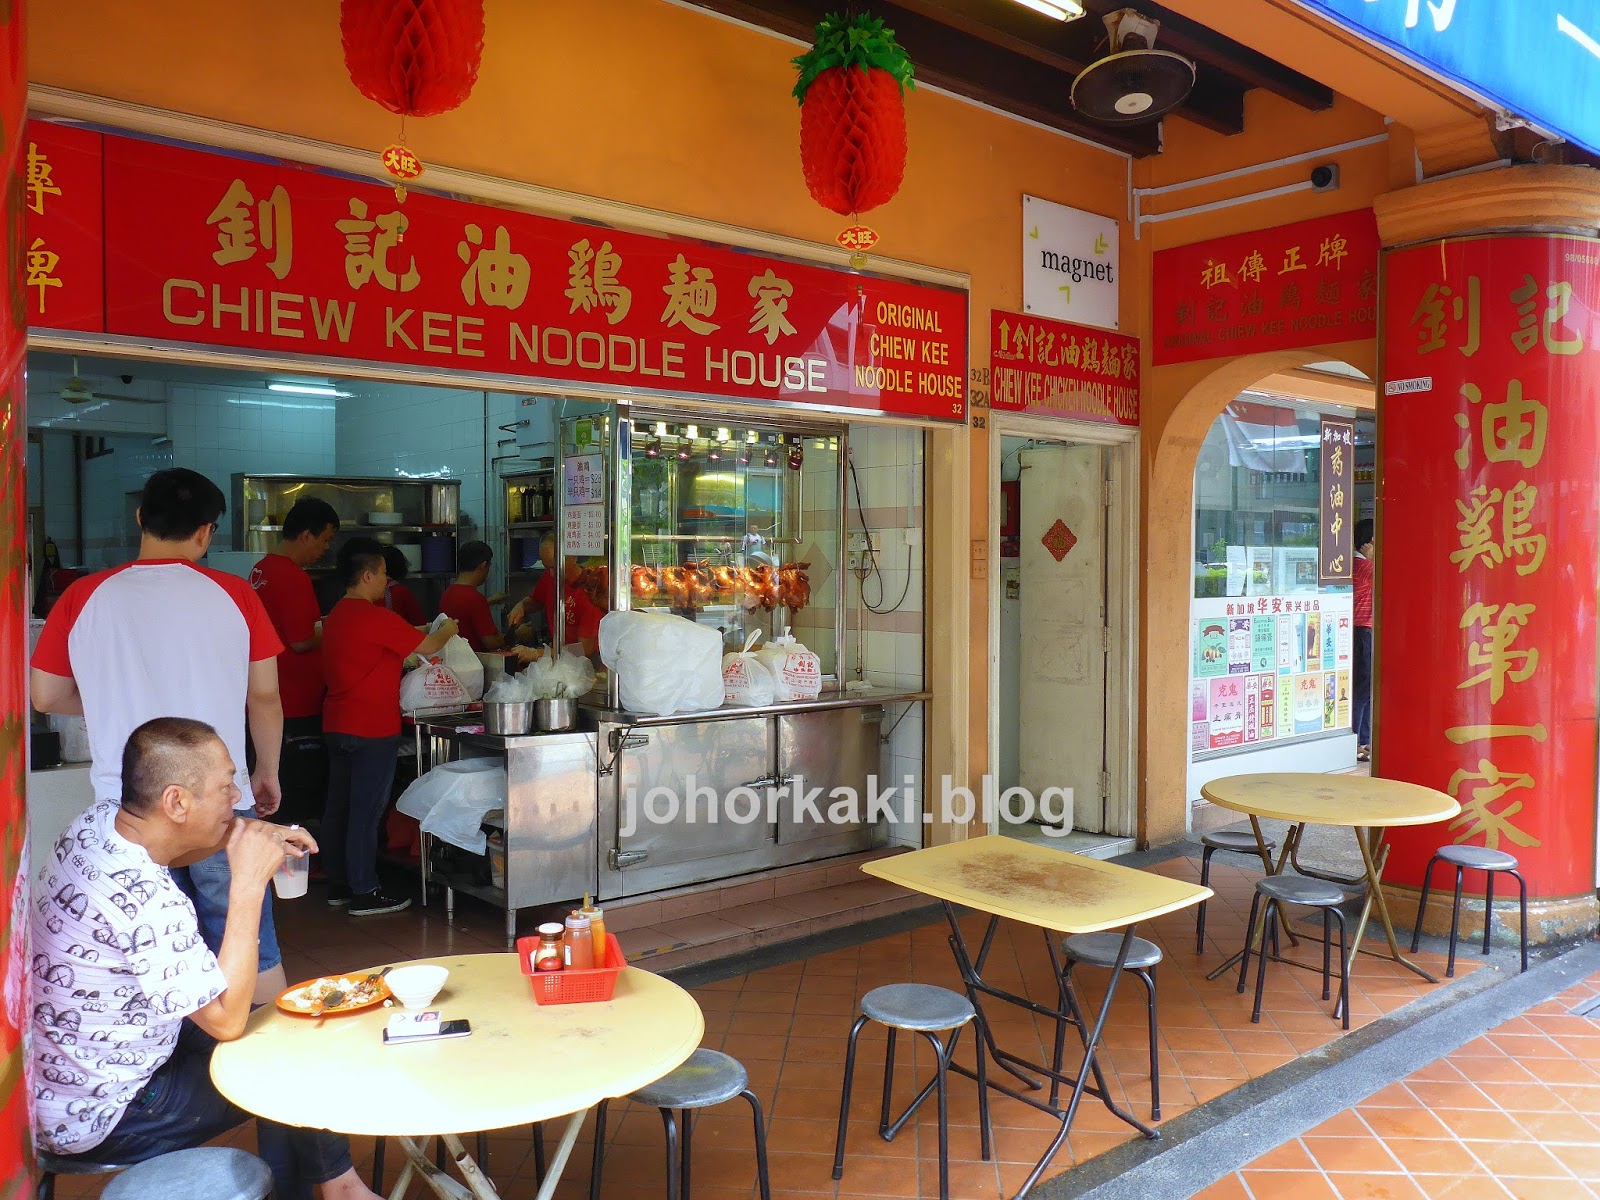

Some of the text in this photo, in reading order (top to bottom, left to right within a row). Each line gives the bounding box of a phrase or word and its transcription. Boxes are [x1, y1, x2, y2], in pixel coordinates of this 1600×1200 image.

[385, 150, 419, 175] 大旺
[841, 230, 875, 245] 大旺
[1041, 249, 1114, 284] magnet
[876, 301, 943, 333] ORIGINAL
[1218, 323, 1257, 343] CHIEW
[1262, 319, 1285, 336] KEE
[1290, 311, 1341, 332] NOODLE
[1349, 307, 1377, 324] HOU
[162, 278, 828, 393] CHIEW KEE NOODLE HOUSE
[870, 333, 949, 365] CHIEW KEE
[855, 364, 963, 399] NOODLE HOUSE
[994, 366, 1138, 420] CHIEW KEE CHICKEN NOODLE HOUSE
[1397, 379, 1430, 392] NO SMOKING
[951, 403, 962, 414] 32
[970, 390, 990, 409] 32A
[972, 416, 986, 428] 32
